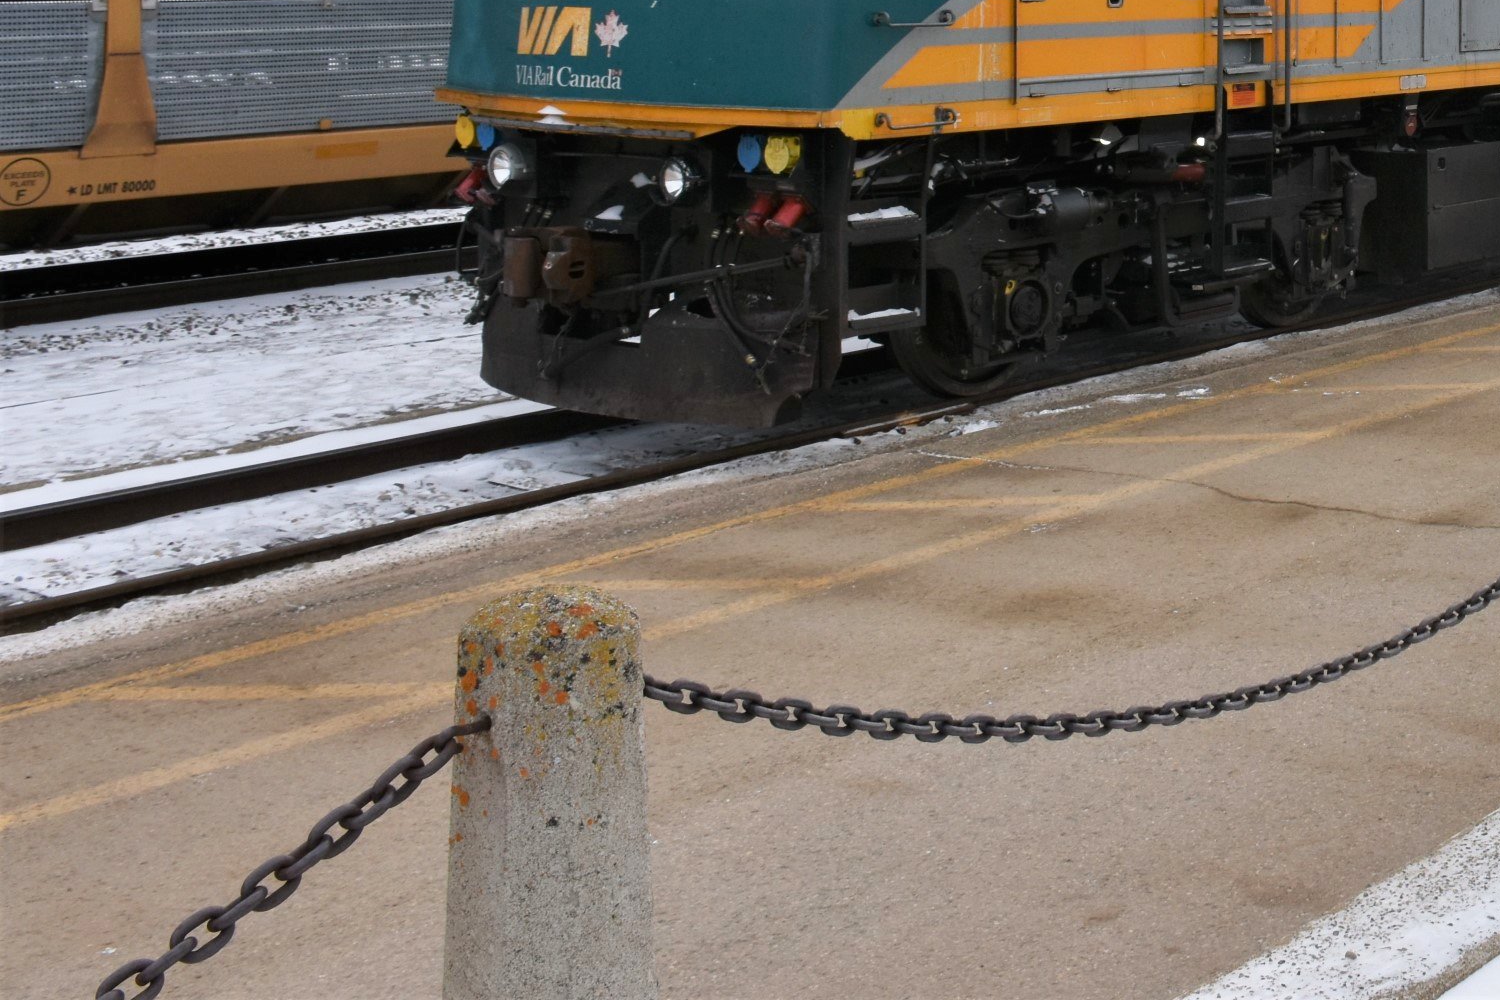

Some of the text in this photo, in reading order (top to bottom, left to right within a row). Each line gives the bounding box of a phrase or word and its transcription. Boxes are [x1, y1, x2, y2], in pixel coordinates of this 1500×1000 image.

[517, 6, 592, 57] VIA
[516, 64, 622, 90] VIA Rail Canada
[3, 170, 45, 181] EXCEEDS
[10, 179, 37, 188] PLATE
[80, 179, 156, 196] LD LMT 80000
[15, 189, 27, 201] F
